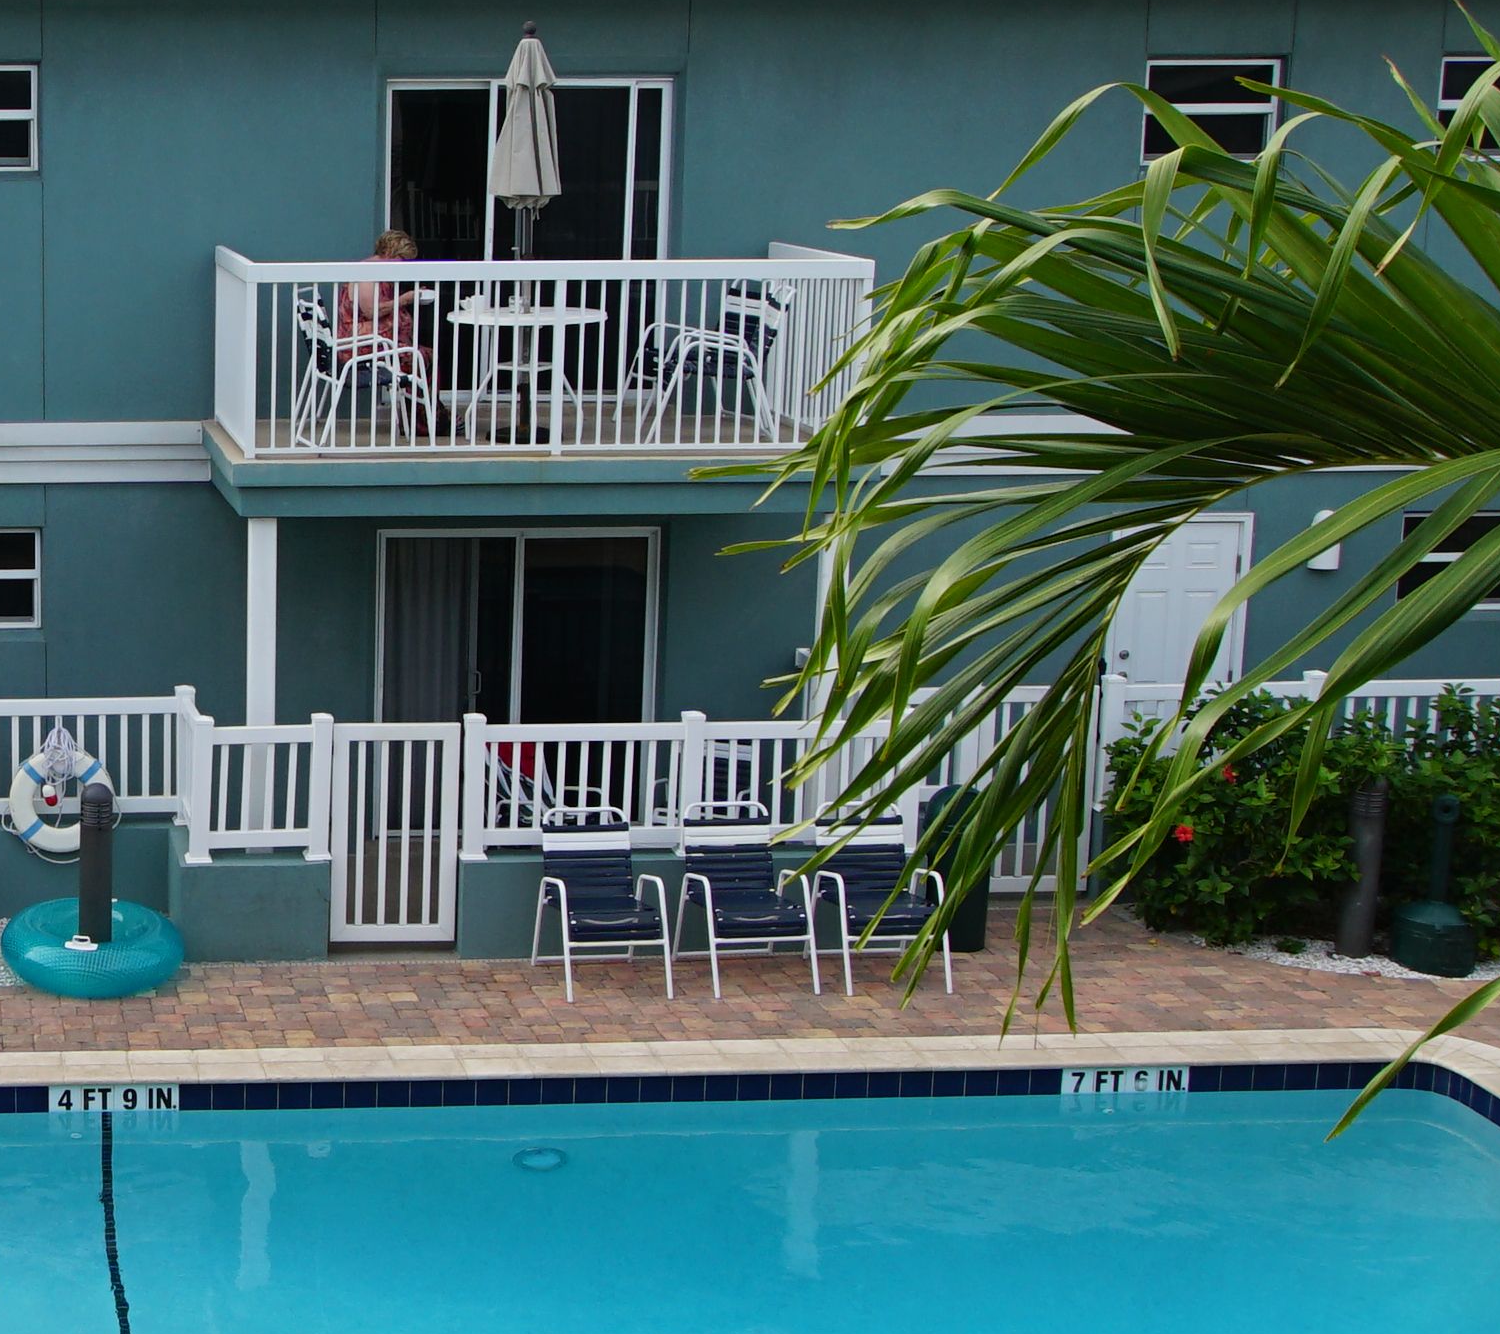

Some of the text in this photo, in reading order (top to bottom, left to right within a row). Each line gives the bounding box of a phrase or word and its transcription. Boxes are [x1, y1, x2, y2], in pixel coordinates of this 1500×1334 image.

[1071, 1070, 1186, 1093] 7 FT 6 IN.
[58, 1087, 177, 1111] 4 FT 9 IN.
